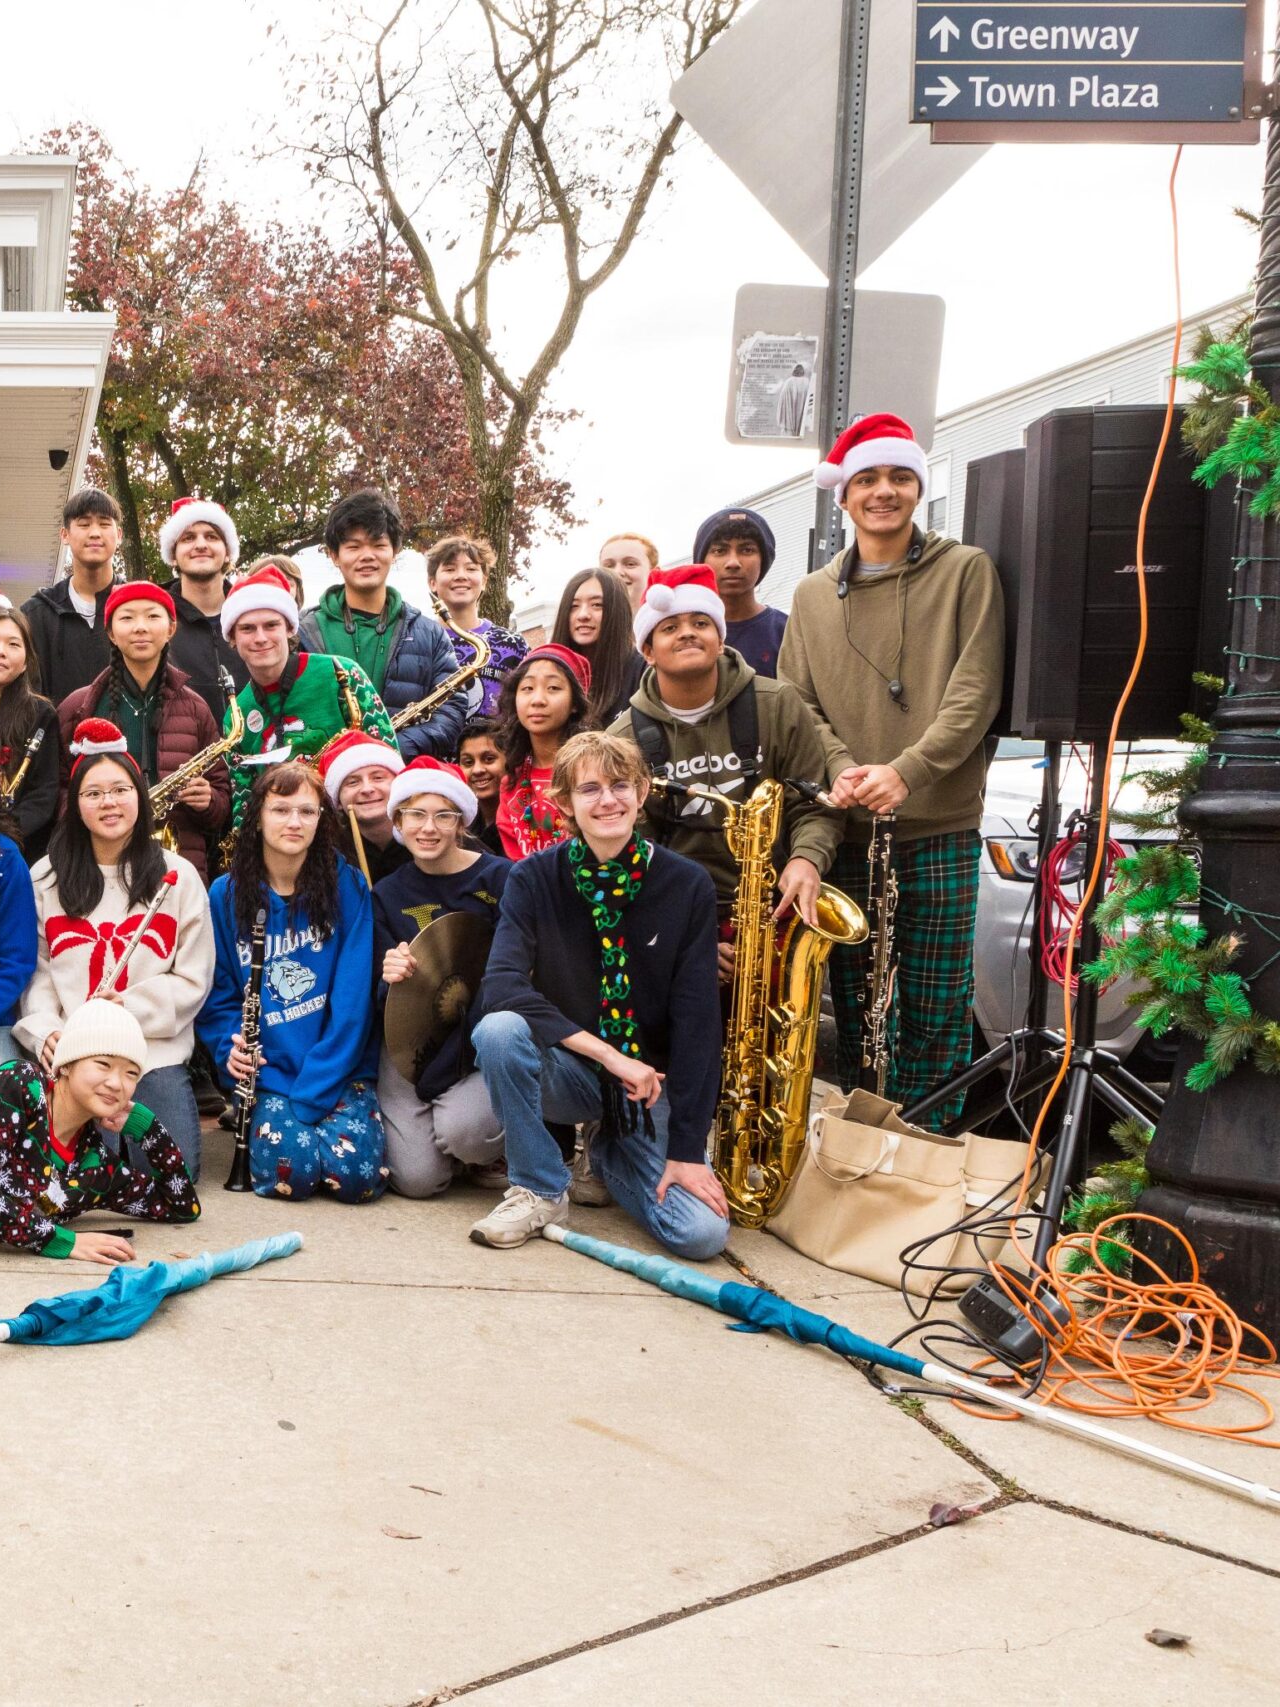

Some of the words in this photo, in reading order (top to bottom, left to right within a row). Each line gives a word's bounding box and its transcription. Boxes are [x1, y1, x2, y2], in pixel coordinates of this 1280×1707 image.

[970, 18, 1139, 58] Greenway
[968, 76, 1056, 108] Town
[1069, 75, 1159, 108] Plaza
[1114, 565, 1167, 573] BSE
